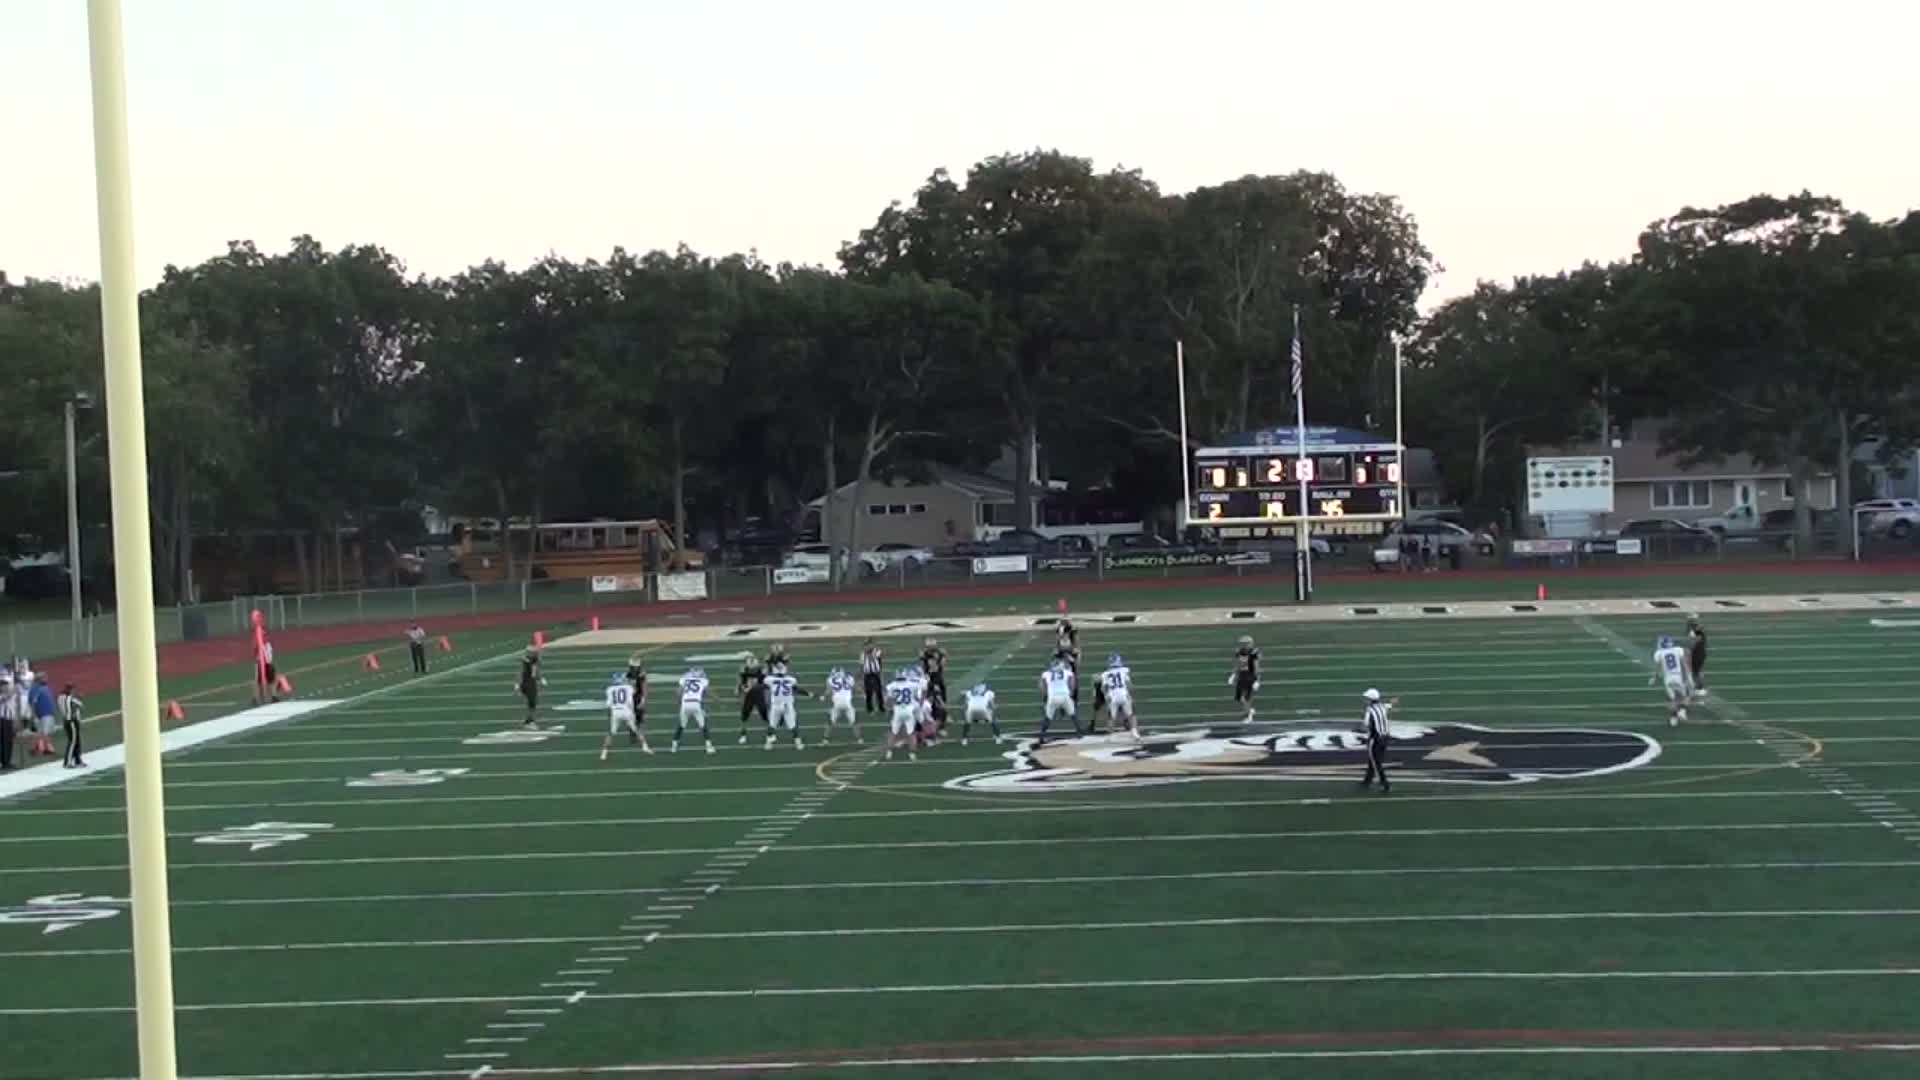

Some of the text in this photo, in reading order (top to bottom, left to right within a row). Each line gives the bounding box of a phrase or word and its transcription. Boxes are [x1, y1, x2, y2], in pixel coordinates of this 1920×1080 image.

[1664, 652, 1677, 670] 8
[772, 679, 793, 697] 75
[1107, 671, 1124, 690] 31
[612, 687, 627, 705] 10
[893, 687, 912, 705] 28
